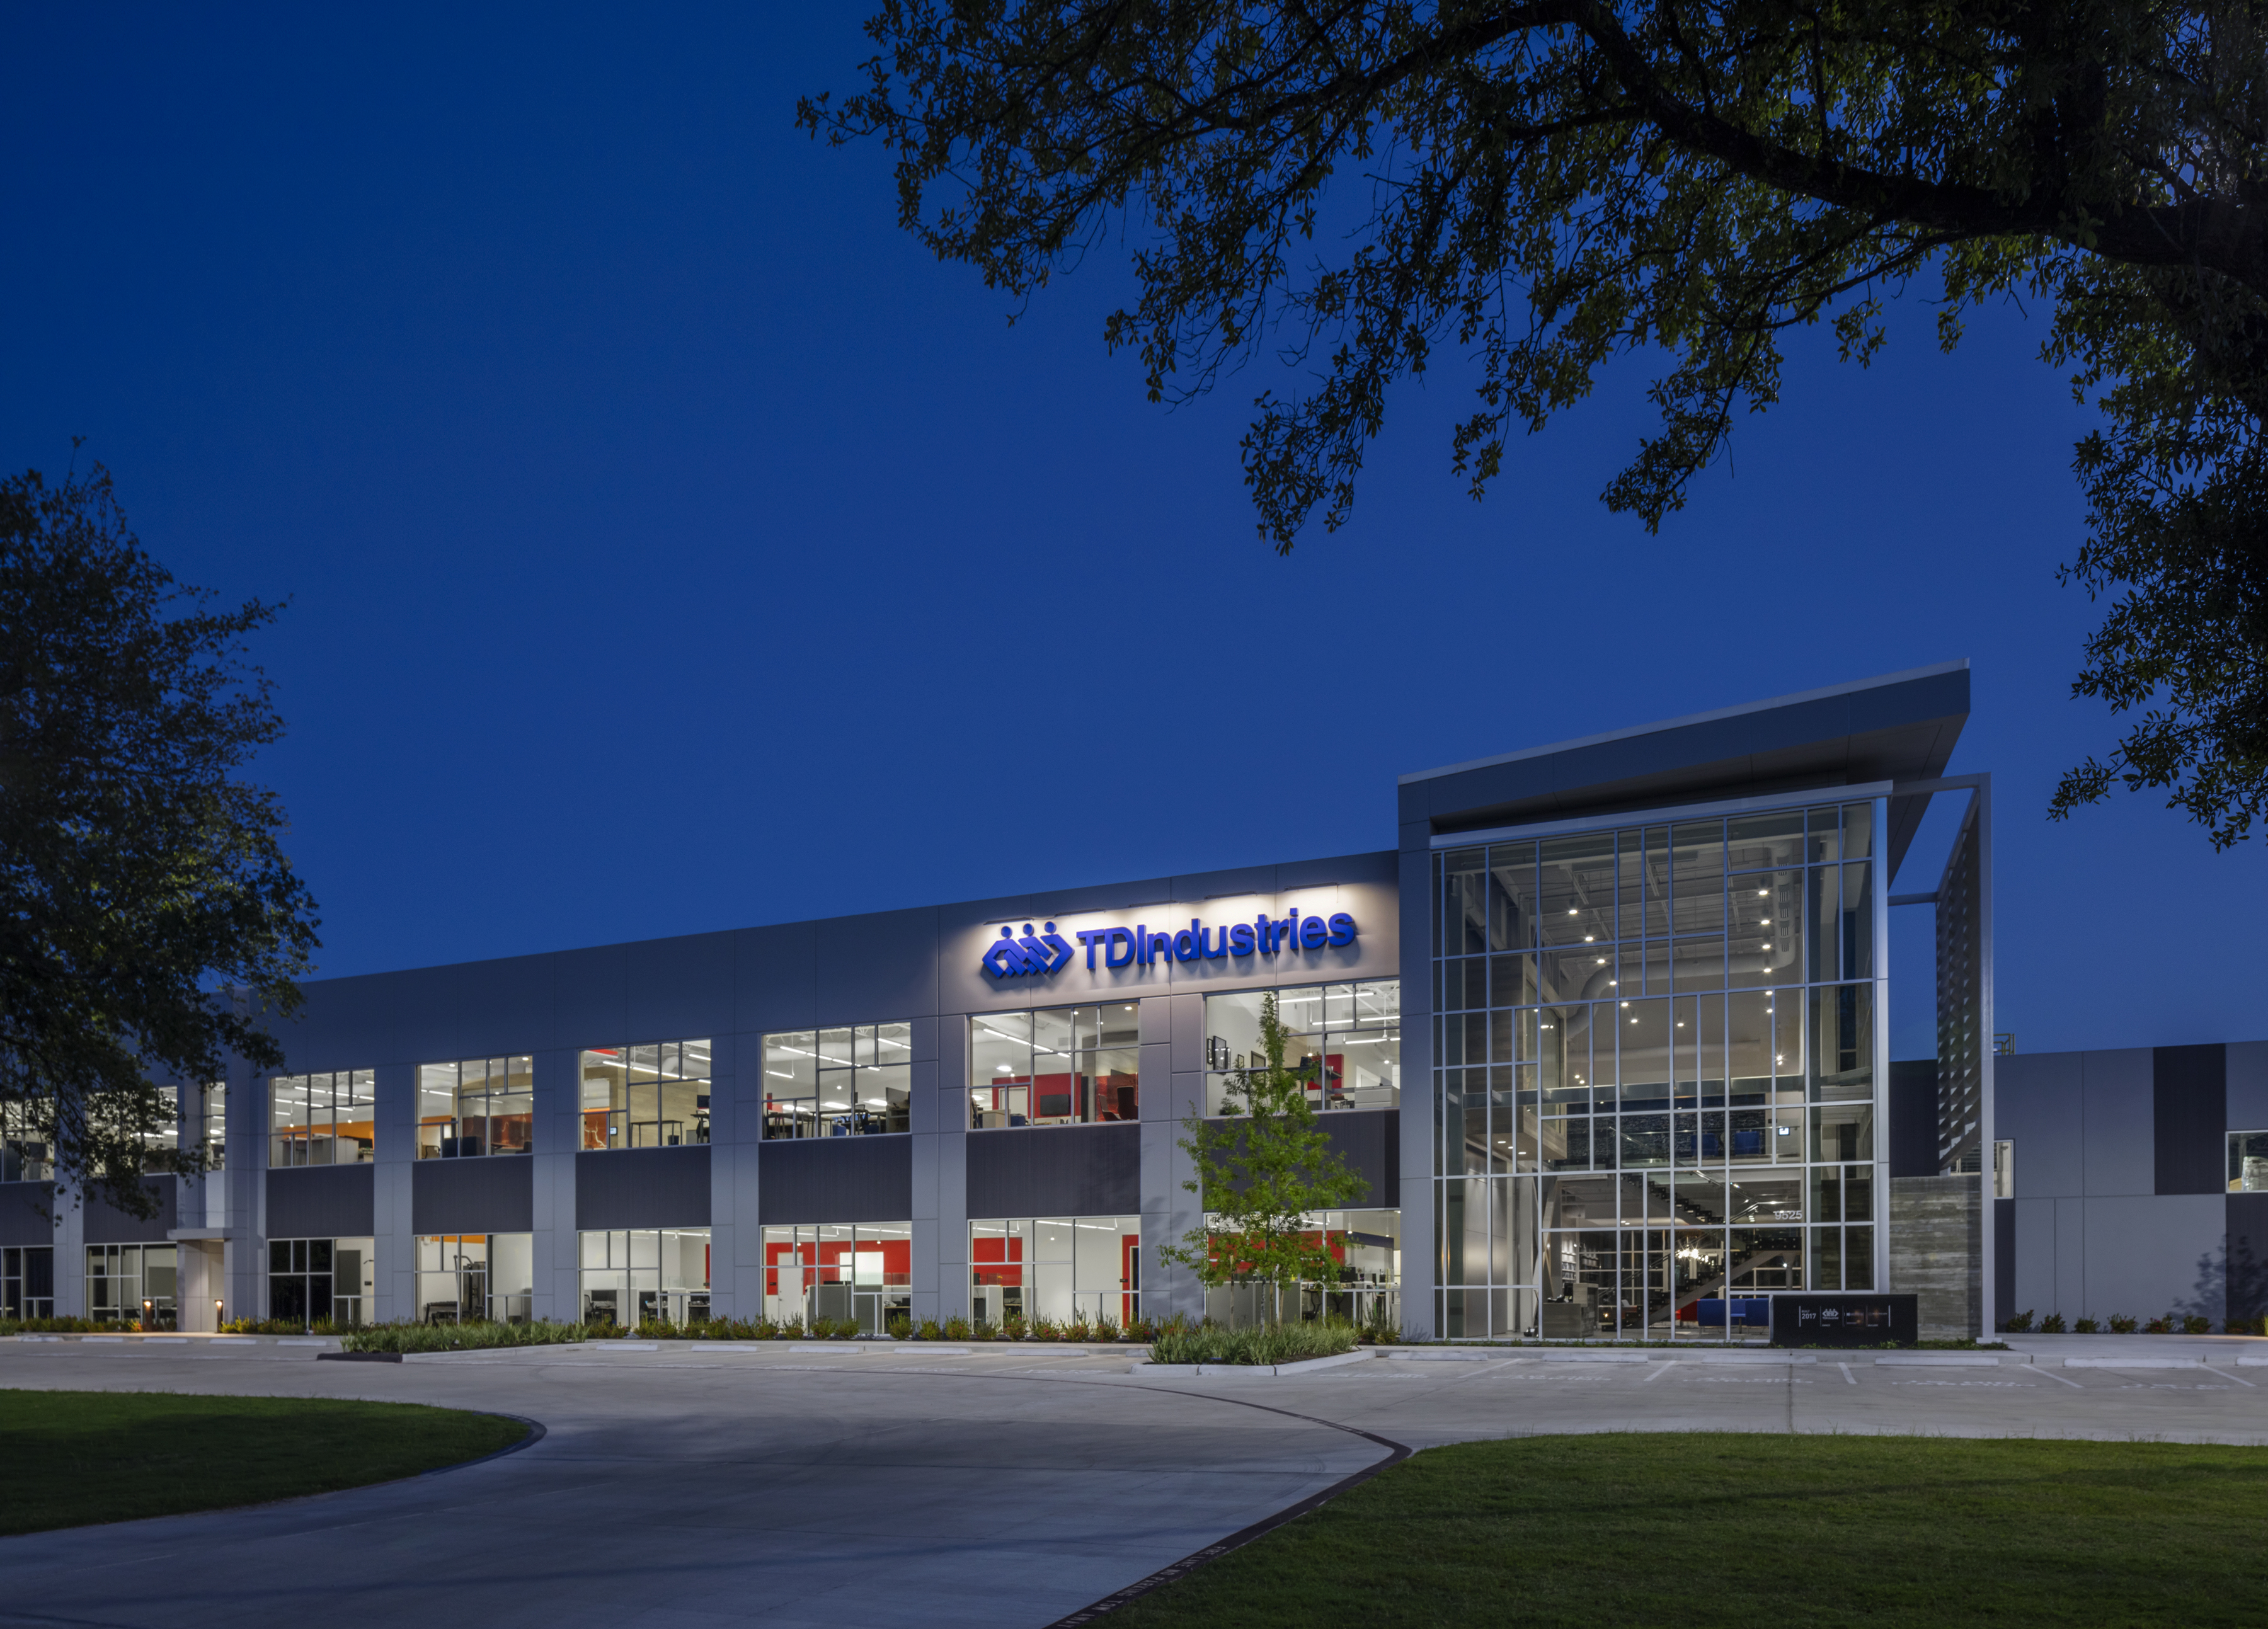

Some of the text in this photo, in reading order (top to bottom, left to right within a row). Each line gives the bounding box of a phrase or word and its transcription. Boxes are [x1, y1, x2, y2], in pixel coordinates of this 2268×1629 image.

[1076, 907, 1356, 969] TDIndustries
[1775, 1210, 1802, 1220] 9525
[1200, 1546, 1227, 1555] FIRE
[1175, 1557, 1206, 1567] LANE
[1116, 1576, 1165, 1596] PARKING
[1092, 1600, 1124, 1611] TOW
[1057, 1613, 1096, 1628] AWAY
